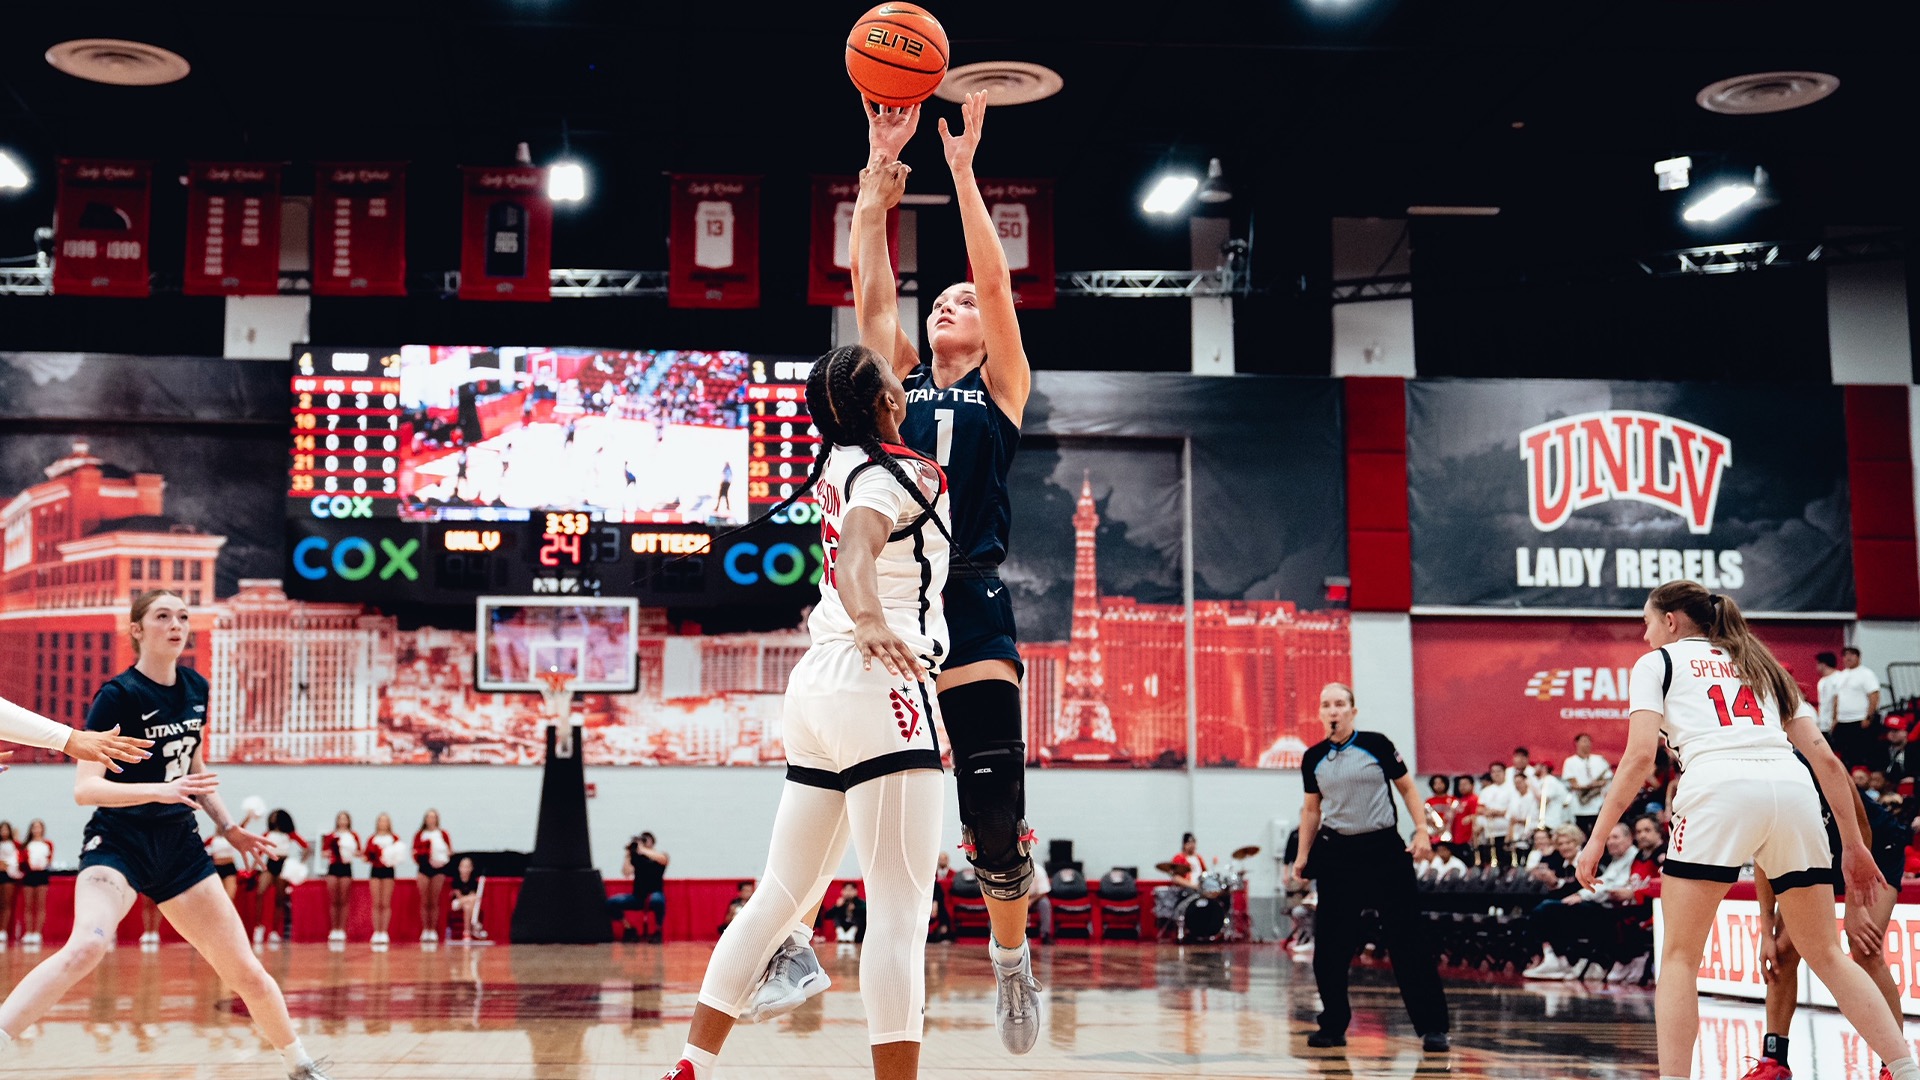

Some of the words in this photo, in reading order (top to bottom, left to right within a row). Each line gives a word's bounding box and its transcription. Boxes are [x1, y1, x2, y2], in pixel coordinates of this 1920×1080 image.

[866, 27, 925, 58] ELITE
[327, 393, 340, 410] 0
[383, 393, 397, 410] 0
[905, 387, 944, 404] TAH
[327, 414, 340, 432] 7
[357, 415, 367, 431] 1
[387, 415, 398, 431] 1
[326, 434, 339, 451] 0
[354, 435, 367, 452] 0
[383, 435, 396, 452] 0
[934, 408, 955, 467] 1
[780, 441, 793, 458] 2
[325, 455, 339, 472] 0
[353, 455, 367, 472] 0
[382, 457, 396, 474] 0
[779, 462, 792, 479] 0
[1519, 409, 1733, 535] UNLV
[353, 477, 367, 494] 0
[310, 494, 374, 519] COX
[546, 513, 589, 535] 3:53
[444, 530, 501, 551] UNLV
[539, 533, 581, 566] 24
[292, 535, 420, 581] COX
[1516, 547, 1606, 588] LADY
[1615, 548, 1745, 590] REBELS
[1572, 667, 1632, 701] FAI
[1706, 684, 1765, 727] 14
[144, 723, 184, 739] UTAH
[1697, 914, 1762, 984] ADY
